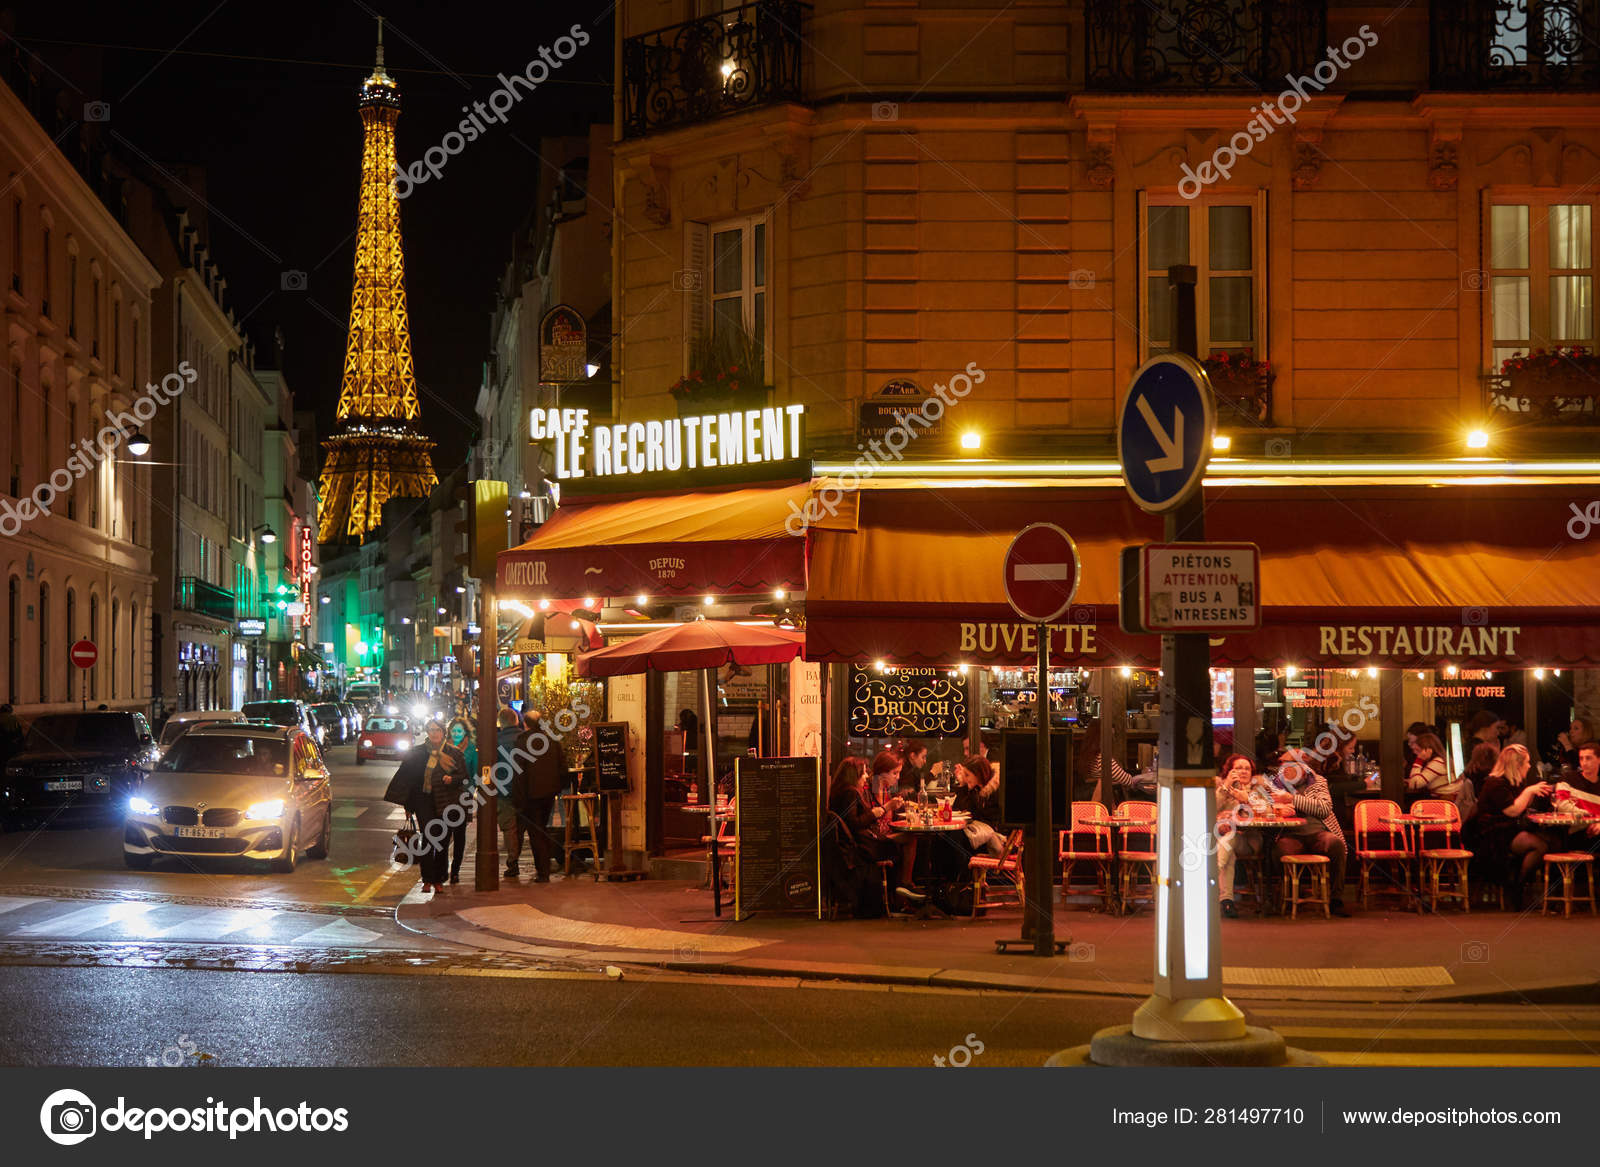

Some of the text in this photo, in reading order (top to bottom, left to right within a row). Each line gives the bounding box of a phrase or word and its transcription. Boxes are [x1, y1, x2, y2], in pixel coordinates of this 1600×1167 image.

[530, 408, 589, 439] CAFE
[556, 404, 804, 479] LE RECRUTEMENT
[649, 557, 685, 570] DEPUIS
[1172, 554, 1232, 568] PIÉTONS
[505, 562, 548, 585] OMPTOIR
[657, 569, 676, 579] 1870
[1163, 573, 1239, 586] ATTENTION
[1180, 591, 1222, 603] BUS A
[1174, 608, 1248, 620] NTRESENS
[960, 623, 1097, 653] BUVETTE
[1320, 626, 1520, 655] RESTAURANT
[806, 671, 820, 681] BA
[1030, 692, 1063, 702] DNK
[1422, 686, 1505, 698] SPECIALITY COFFEE
